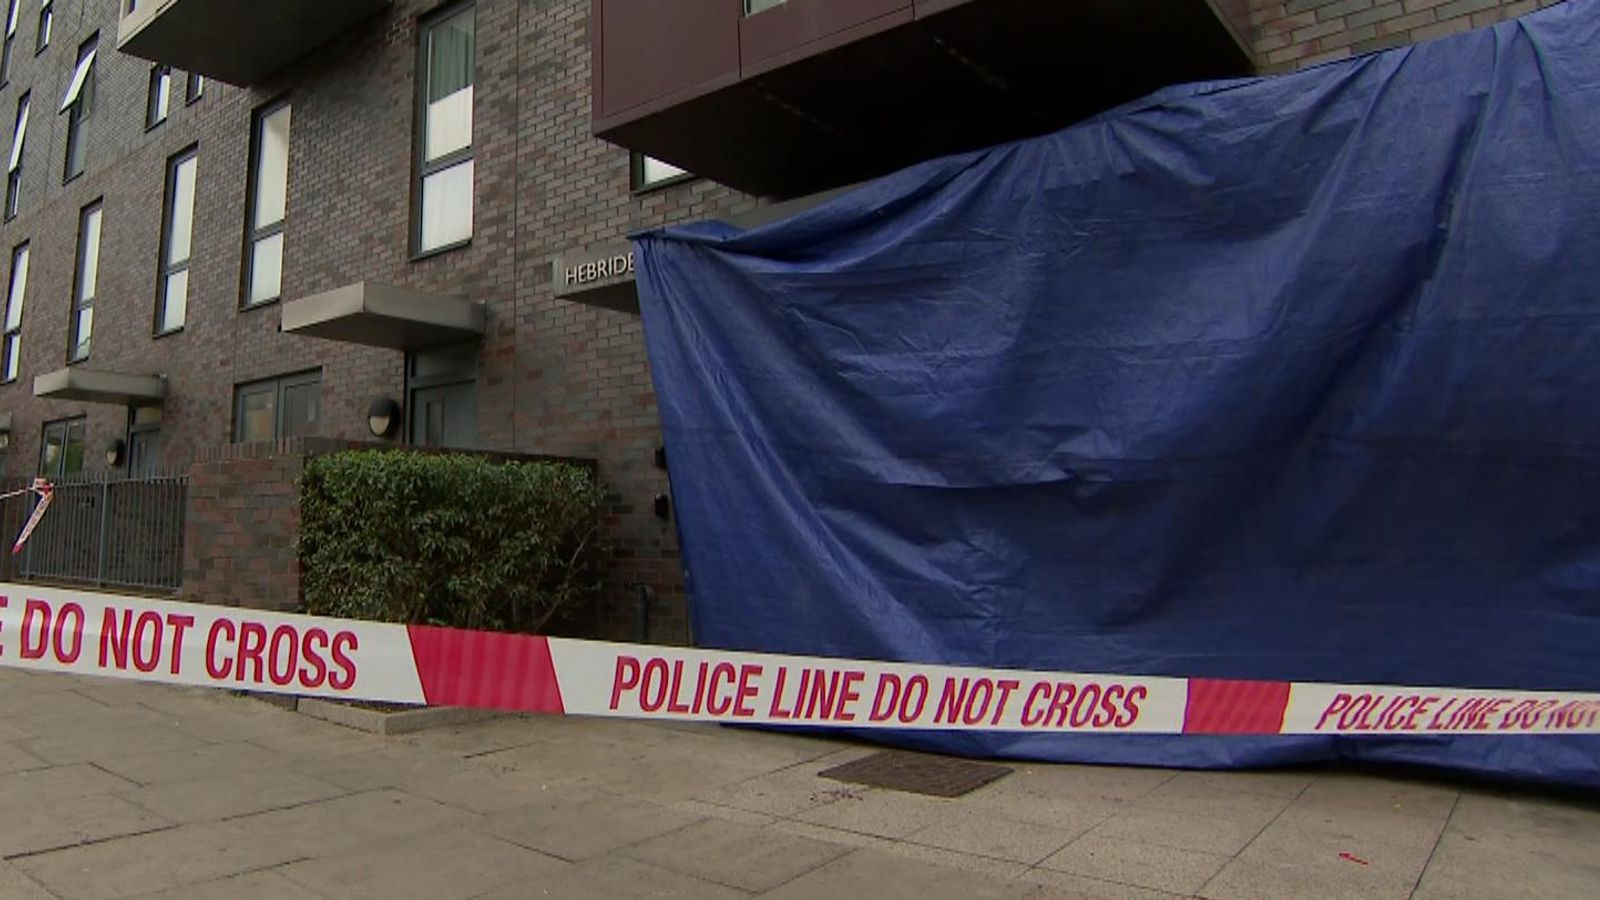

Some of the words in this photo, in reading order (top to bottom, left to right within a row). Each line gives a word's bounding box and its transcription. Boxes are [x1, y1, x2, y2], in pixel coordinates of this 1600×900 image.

[20, 598, 85, 664] DO
[99, 607, 195, 675] NOT
[205, 617, 358, 690] CROSS
[609, 655, 763, 717] POLICE
[768, 666, 865, 721] LINE
[868, 672, 929, 724] DO
[933, 677, 1020, 726] NOT
[1020, 681, 1147, 728] CROSS
[1314, 693, 1440, 730] POLICE
[1426, 697, 1513, 731] LINE
[1497, 699, 1560, 731] DO
